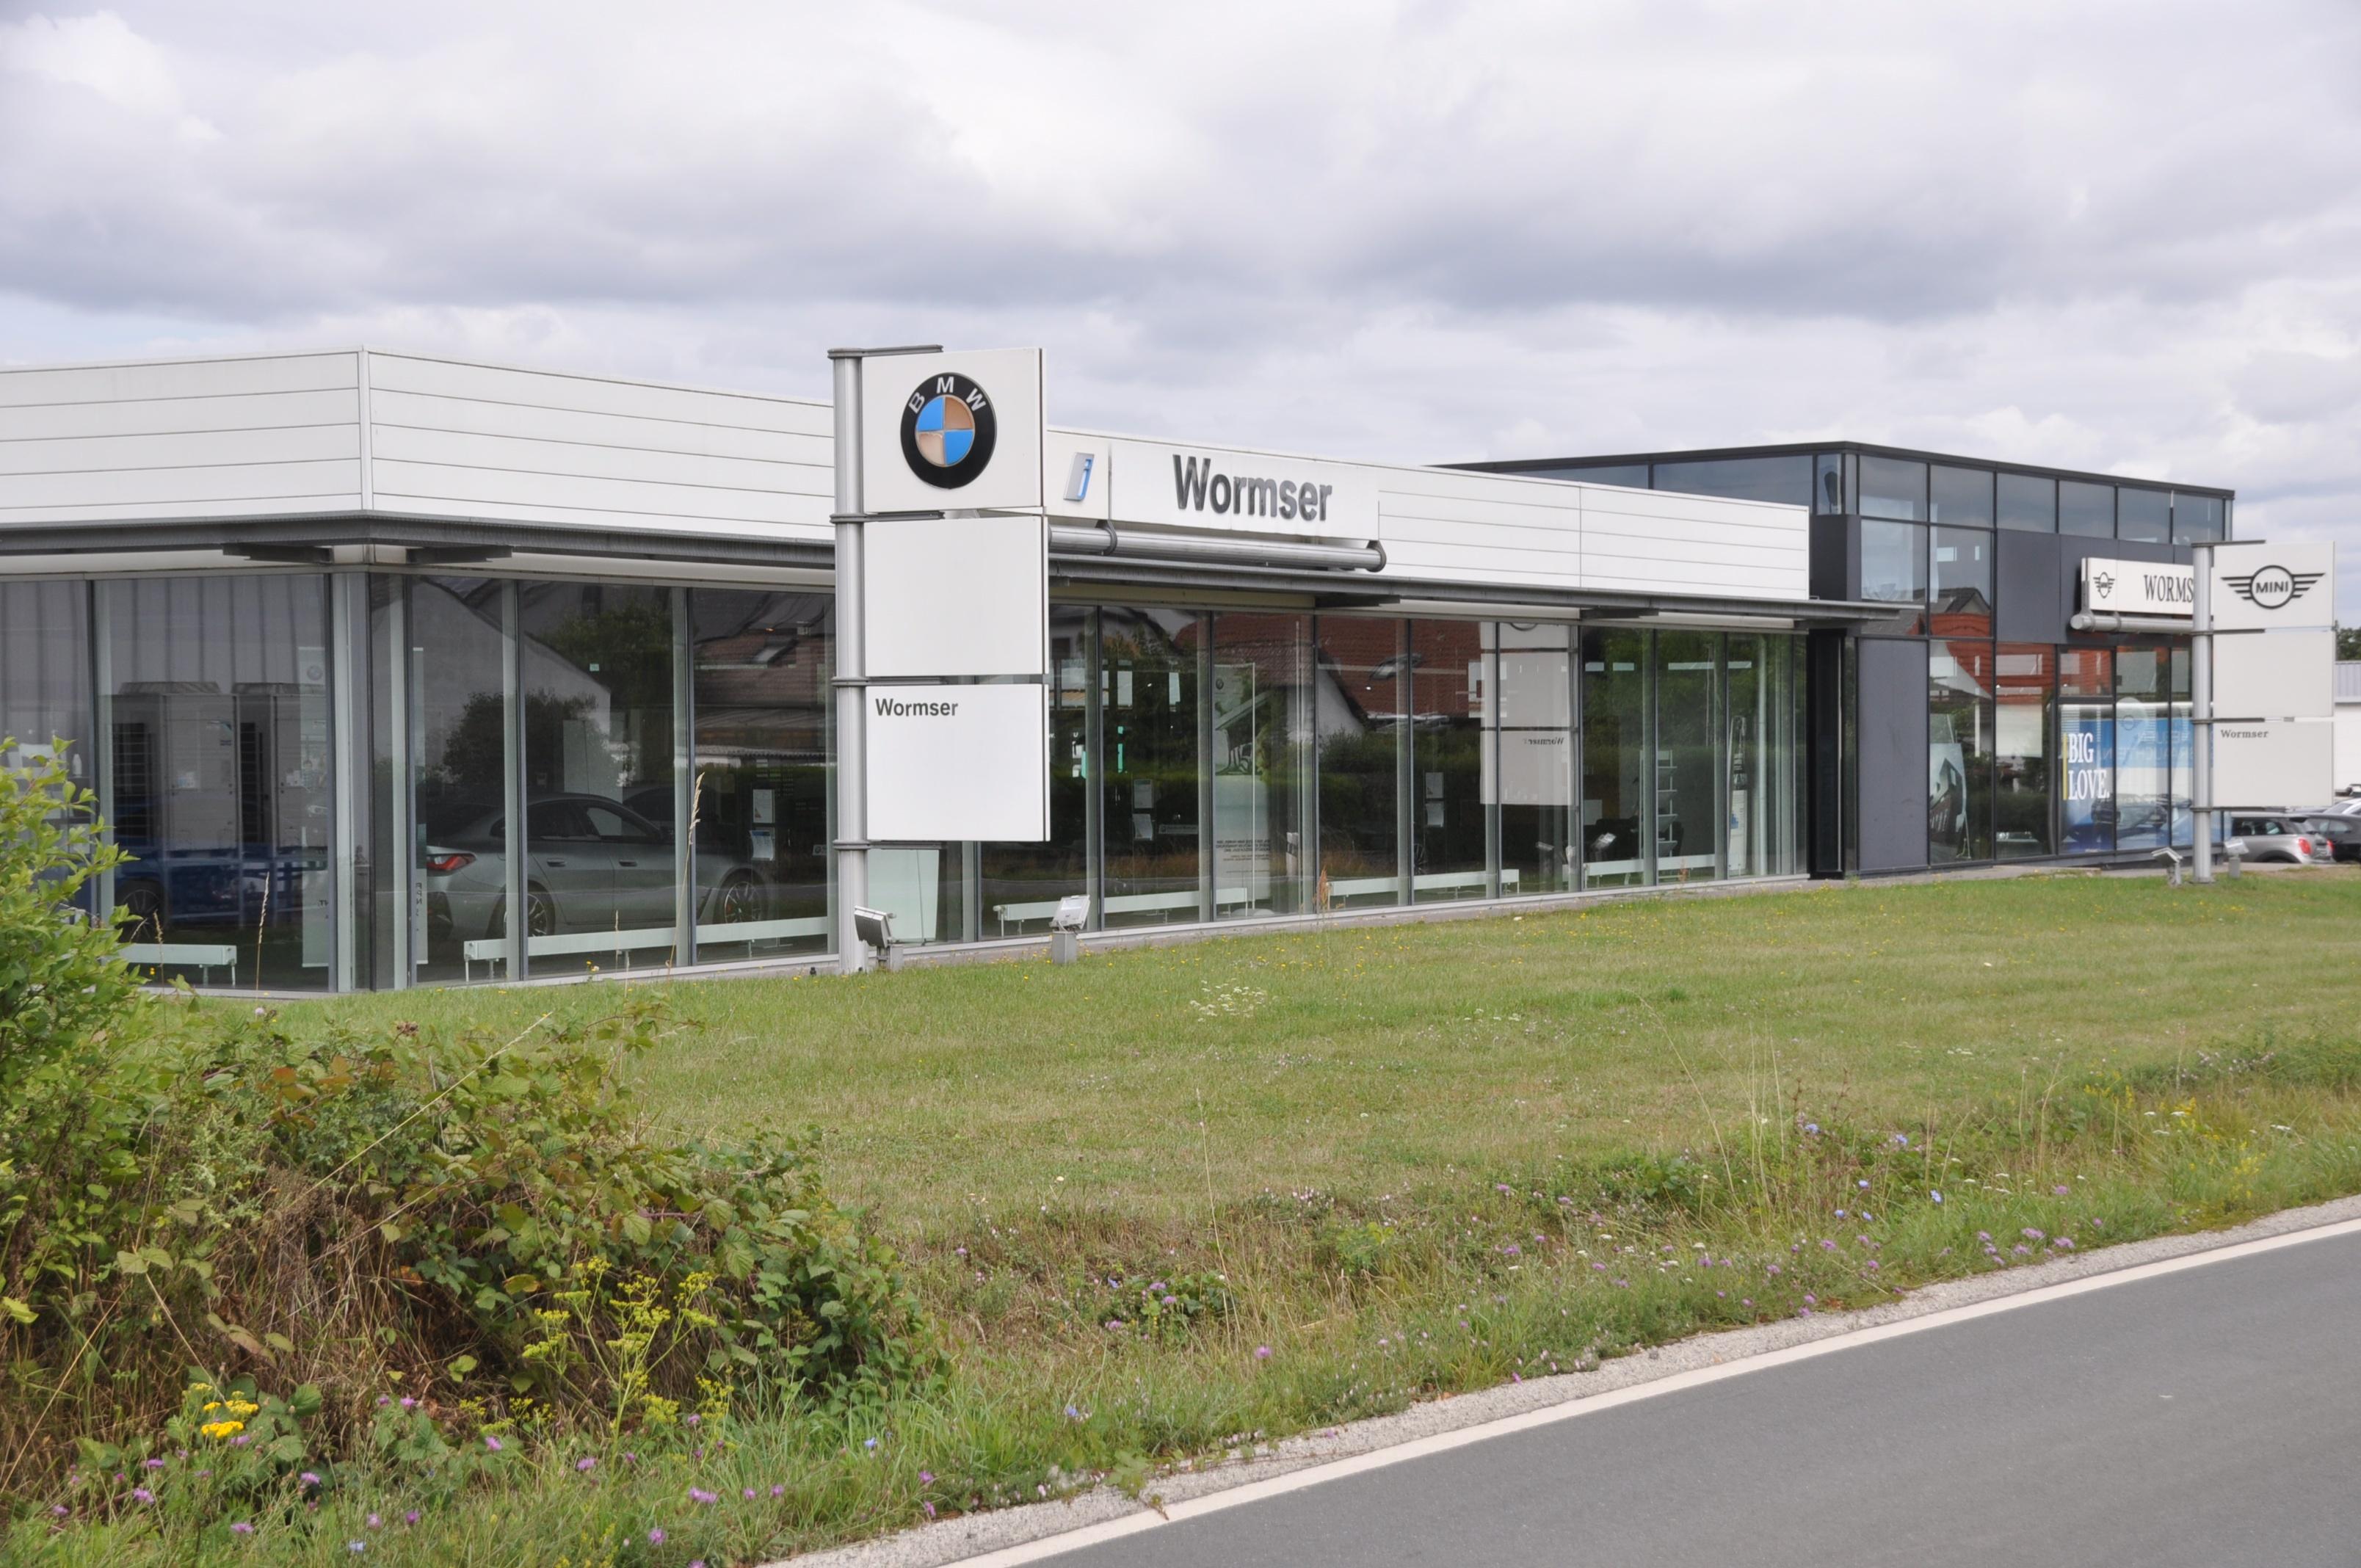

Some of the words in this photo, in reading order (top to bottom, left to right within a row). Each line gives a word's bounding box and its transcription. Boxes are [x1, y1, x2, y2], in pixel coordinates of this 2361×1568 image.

[908, 376, 987, 413] BMW
[1172, 454, 1332, 521] Wormser
[2143, 574, 2194, 603] WORMS
[2255, 581, 2289, 593] MINI
[875, 698, 958, 716] Wormser
[2067, 733, 2094, 763] BIG
[2221, 729, 2268, 738] Wormser
[2067, 769, 2111, 800] LOVE.
